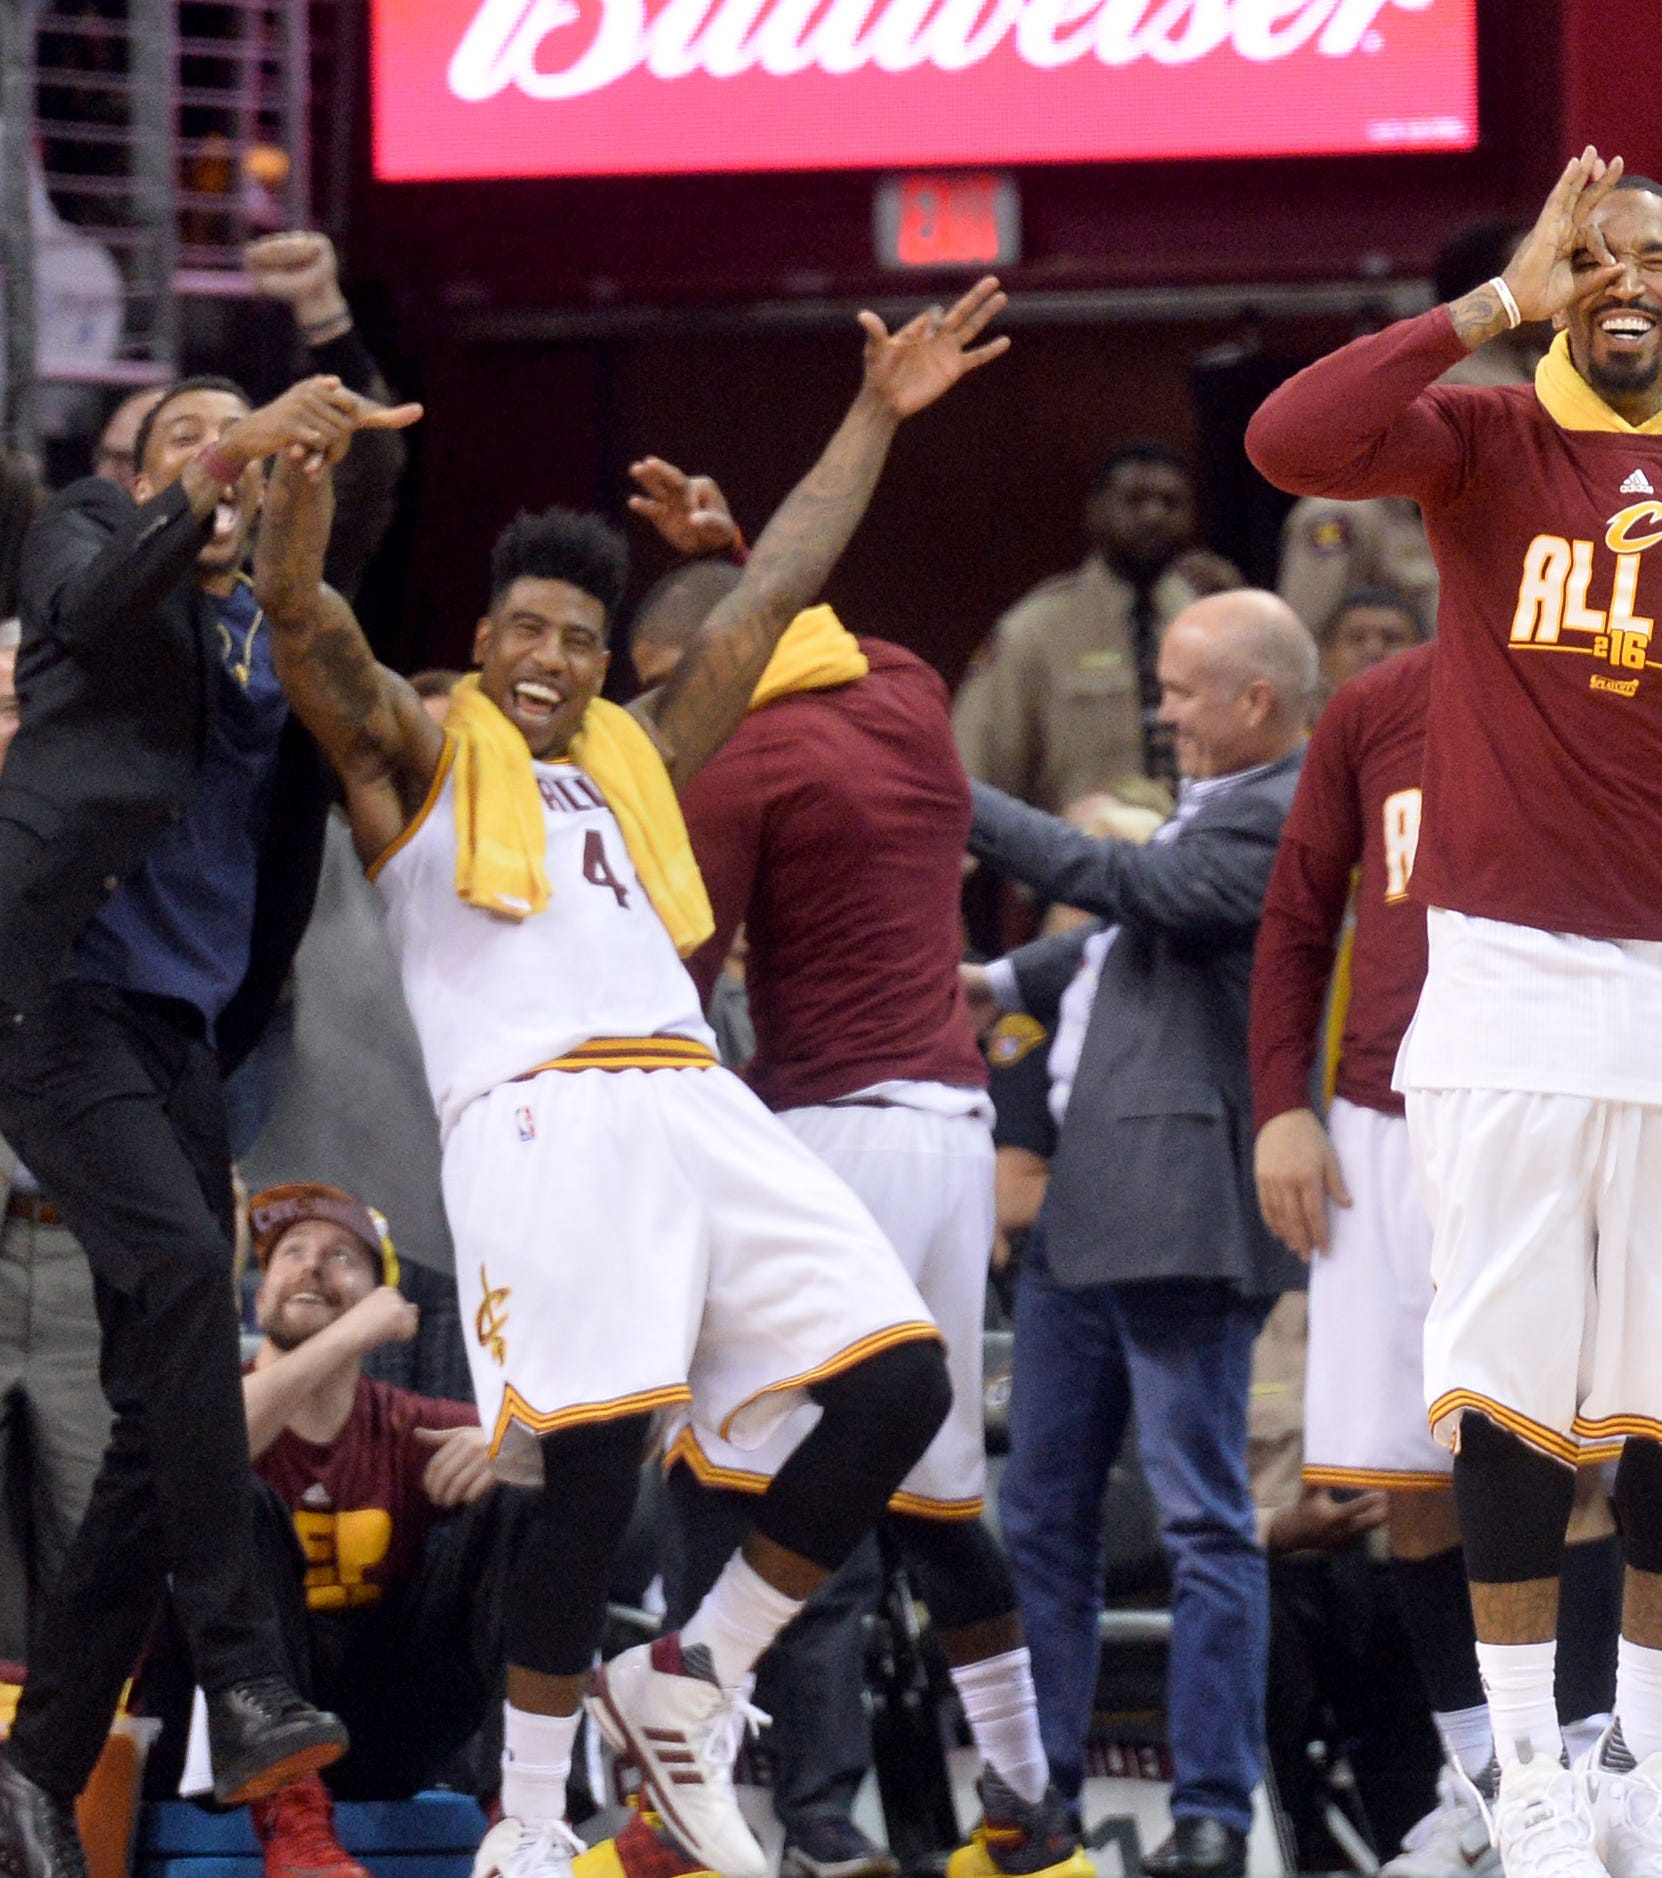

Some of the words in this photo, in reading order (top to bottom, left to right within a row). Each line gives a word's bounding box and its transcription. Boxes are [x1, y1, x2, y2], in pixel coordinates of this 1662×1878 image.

[1510, 533, 1655, 644] ALL
[1593, 628, 1649, 671] 216
[583, 829, 631, 911] 4
